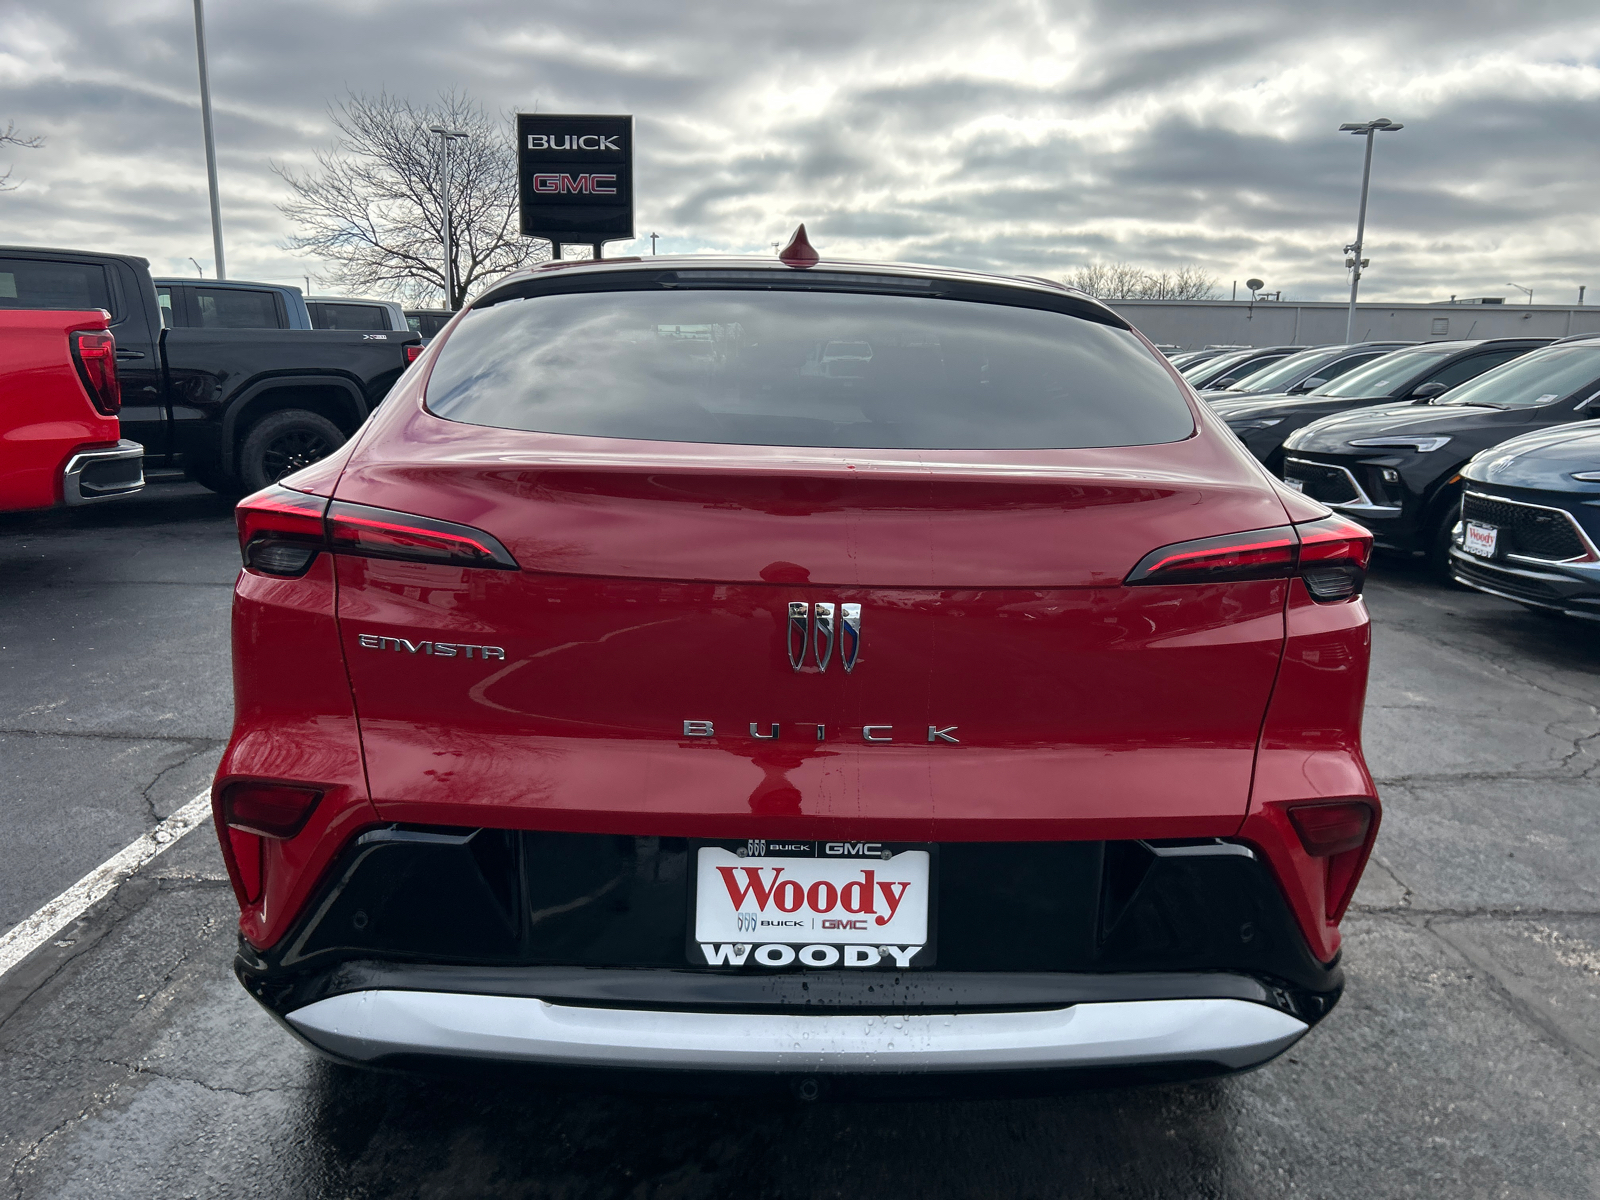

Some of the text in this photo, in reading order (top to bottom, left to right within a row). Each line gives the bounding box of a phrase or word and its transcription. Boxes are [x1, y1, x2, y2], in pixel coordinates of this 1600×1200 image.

[527, 134, 621, 150] BUICK
[533, 173, 617, 194] GMC
[1470, 528, 1494, 547] Woody
[358, 633, 505, 660] ENVISTA
[683, 719, 960, 743] BUICK
[769, 842, 882, 855] BUICK GMC
[715, 866, 911, 926] Woody
[760, 918, 868, 930] BUICK GMC
[700, 943, 923, 967] WOODY
